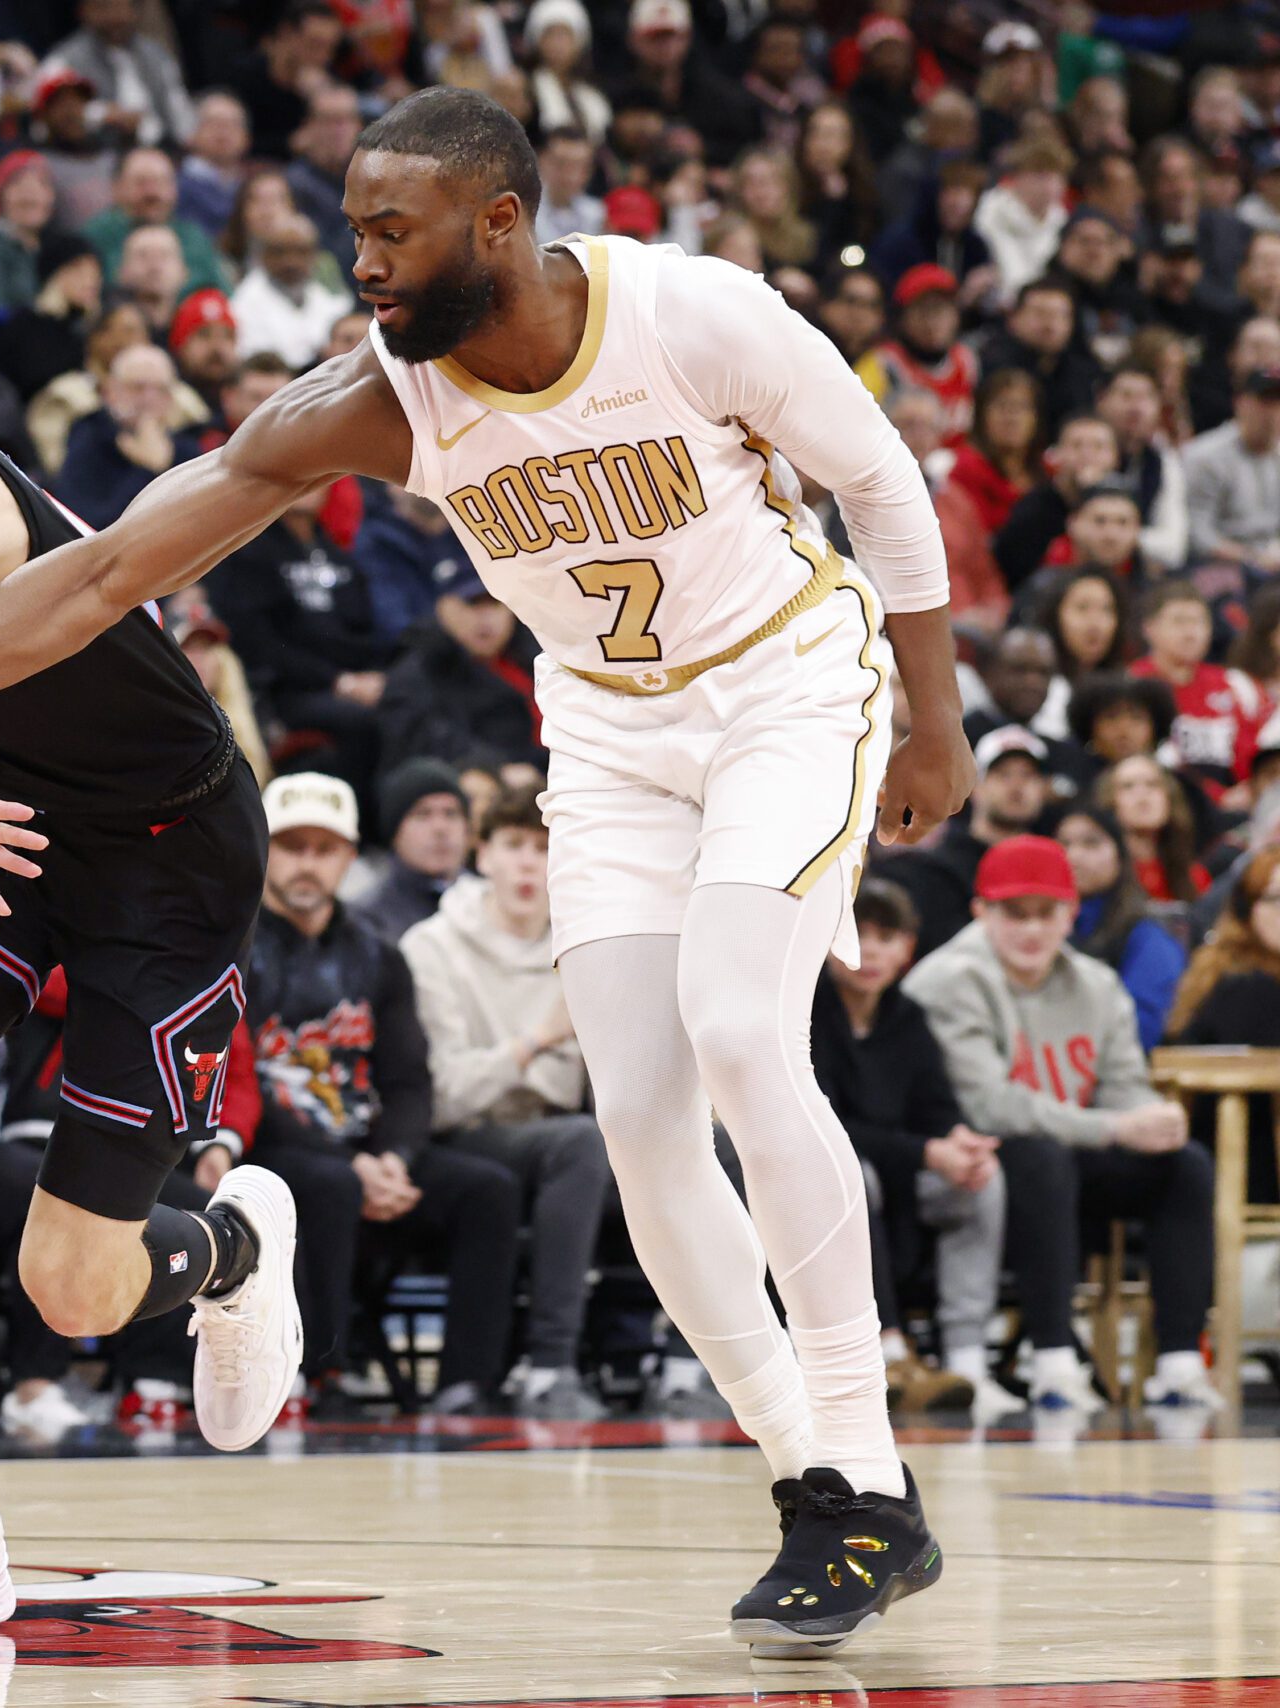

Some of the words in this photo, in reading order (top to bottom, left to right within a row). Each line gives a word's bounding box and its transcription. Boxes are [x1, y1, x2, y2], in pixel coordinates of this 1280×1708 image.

[580, 386, 648, 419] Amica
[446, 435, 708, 561] BOSTON
[566, 558, 665, 663] 7
